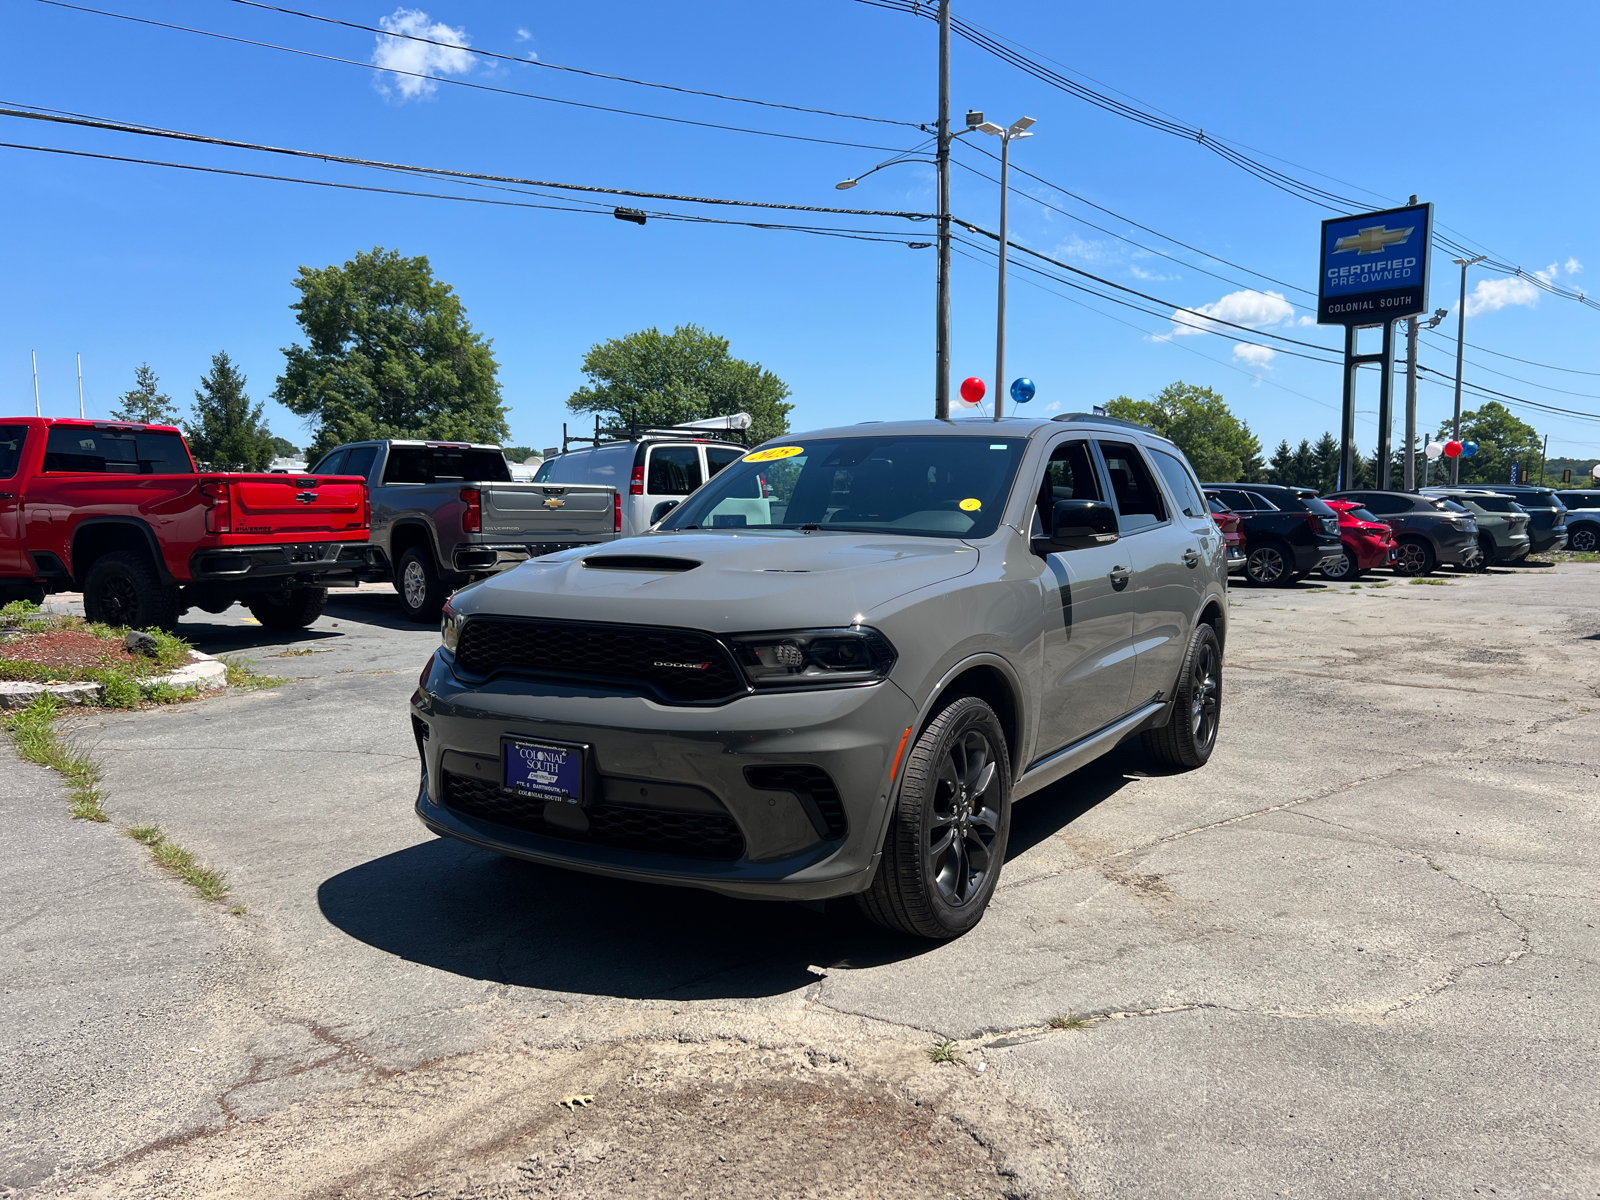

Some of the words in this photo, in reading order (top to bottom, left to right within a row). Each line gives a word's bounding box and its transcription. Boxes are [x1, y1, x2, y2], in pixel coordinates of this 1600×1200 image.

[1328, 257, 1416, 278] CERTIFIED
[1331, 268, 1411, 287] PRE-OWNED
[1328, 300, 1374, 314] COLONIAL
[1380, 296, 1412, 308] SOUTH
[519, 748, 566, 765] COLONIAL
[527, 760, 559, 773] SOUTH
[530, 773, 556, 781] CHEVROLET
[518, 789, 543, 799] COLONIAL
[544, 794, 562, 802] SOUTH
